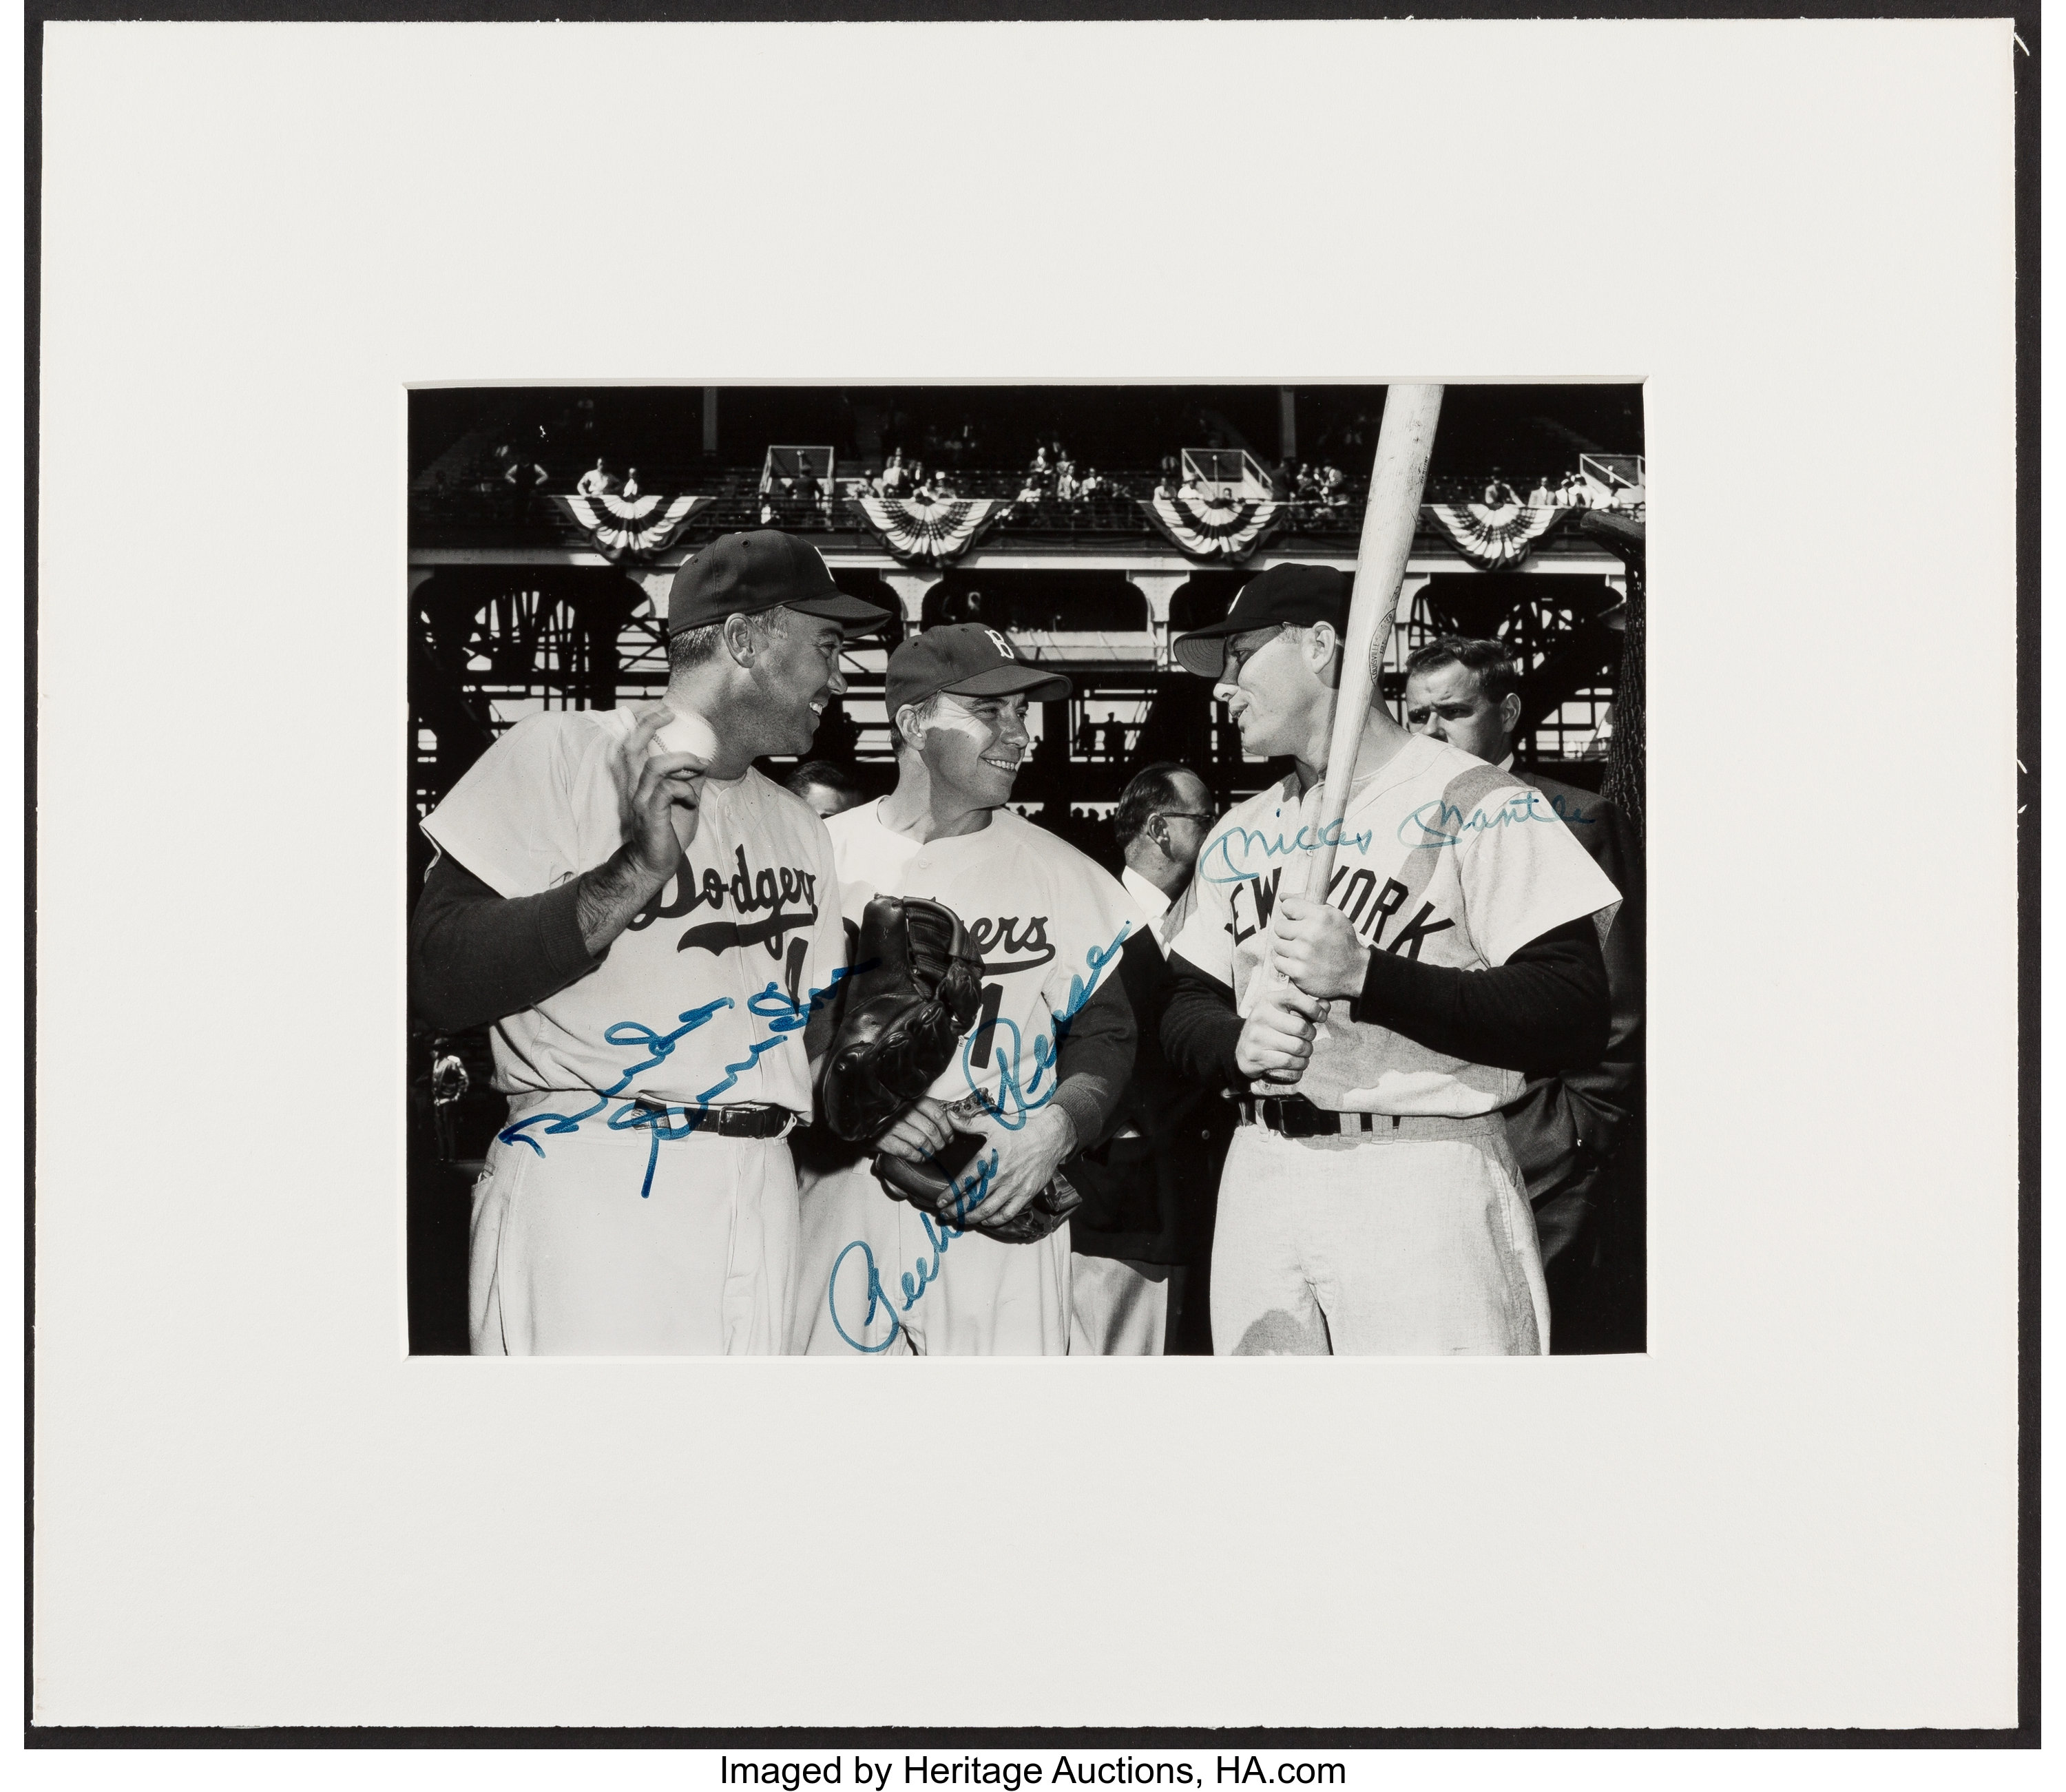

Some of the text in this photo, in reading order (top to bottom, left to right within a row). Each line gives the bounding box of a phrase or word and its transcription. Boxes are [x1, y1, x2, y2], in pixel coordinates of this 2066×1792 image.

[984, 629, 1014, 659] B
[1398, 793, 1597, 849] Mantle
[970, 983, 1004, 1070] 1
